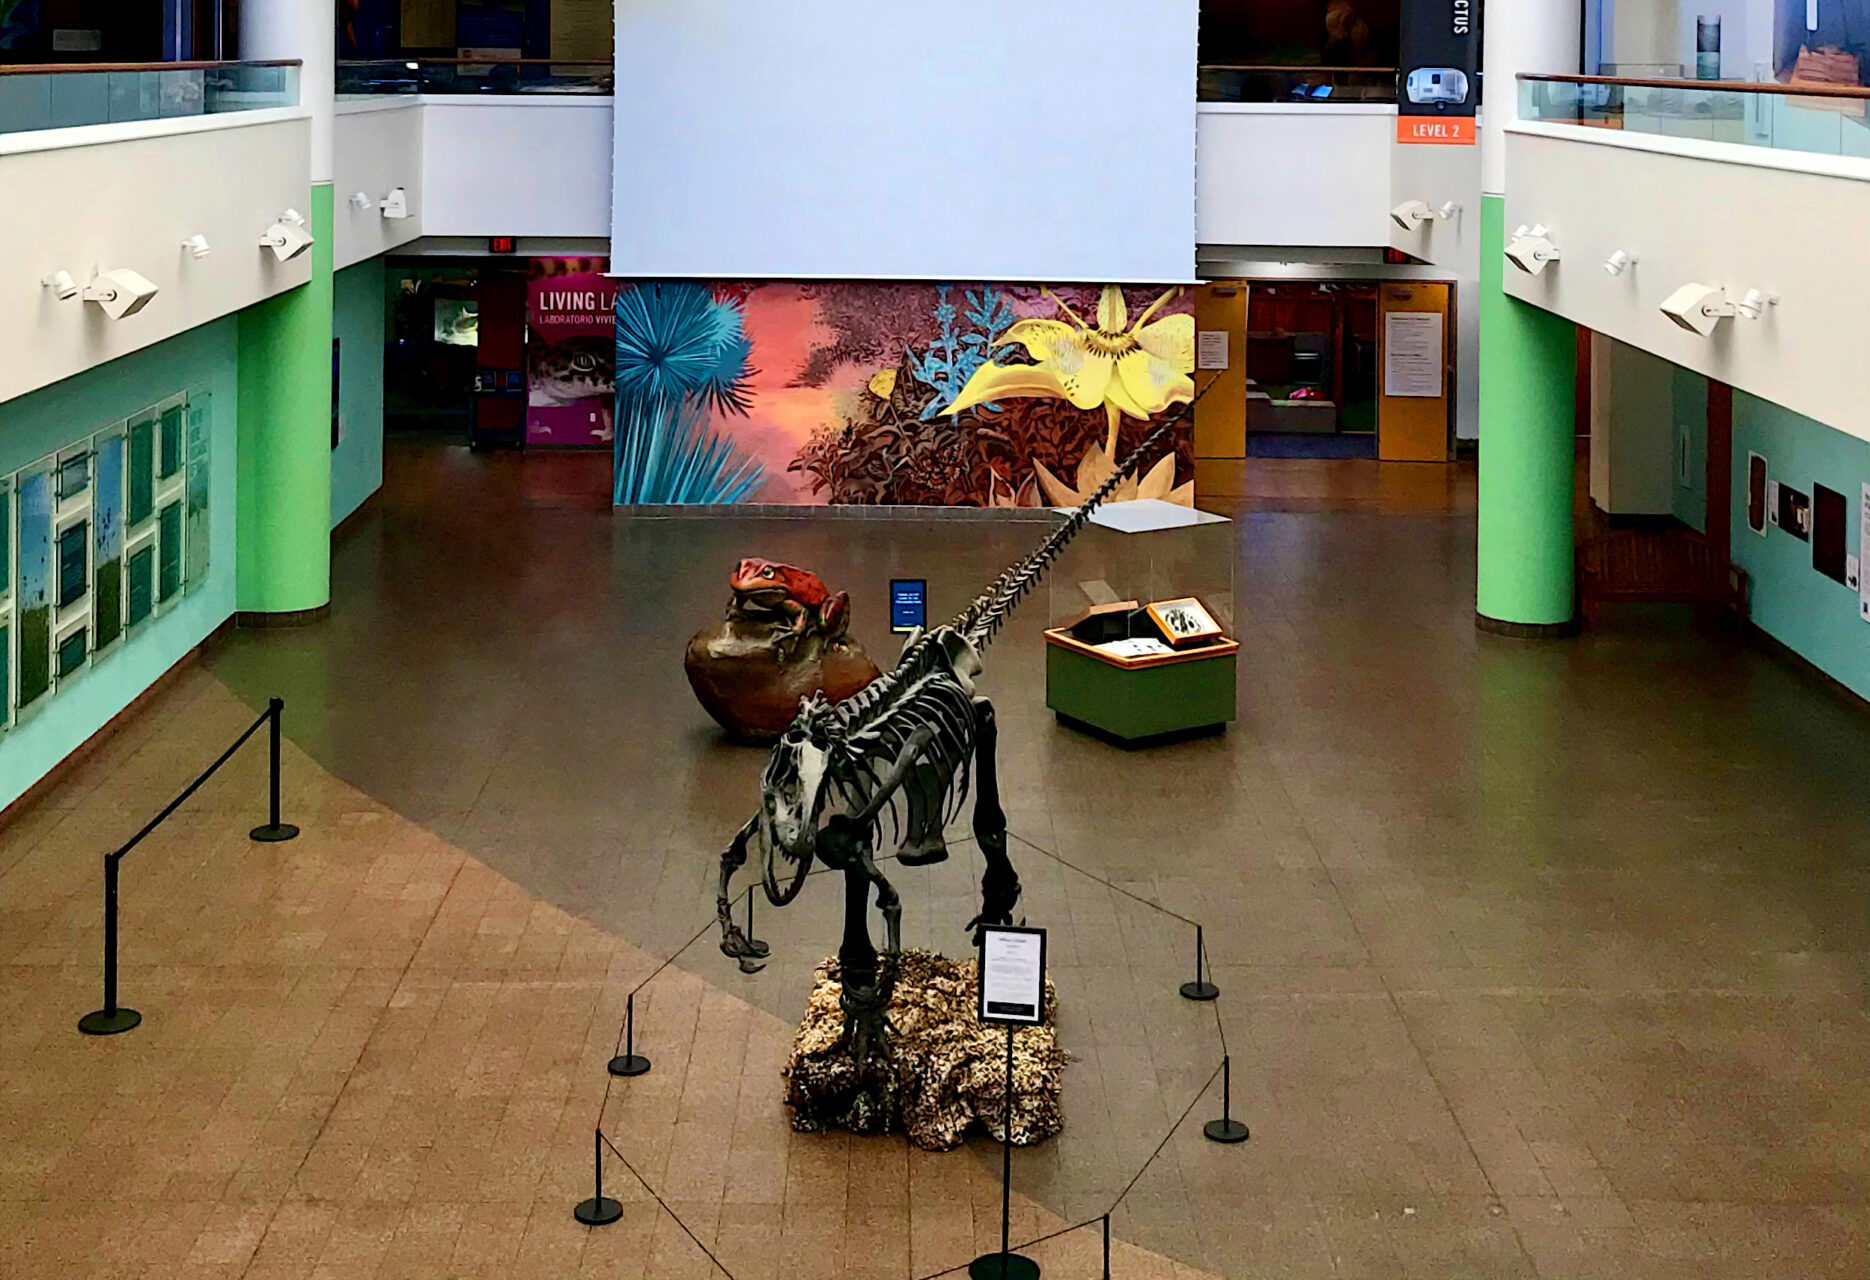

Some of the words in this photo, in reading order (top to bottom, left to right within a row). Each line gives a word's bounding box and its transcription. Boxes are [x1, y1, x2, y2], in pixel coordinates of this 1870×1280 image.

[1413, 124, 1448, 138] LEVEL
[1452, 124, 1459, 138] 2
[493, 238, 511, 252] EXIT
[540, 292, 596, 310] LIVING
[539, 314, 594, 325] LABORATORIO
